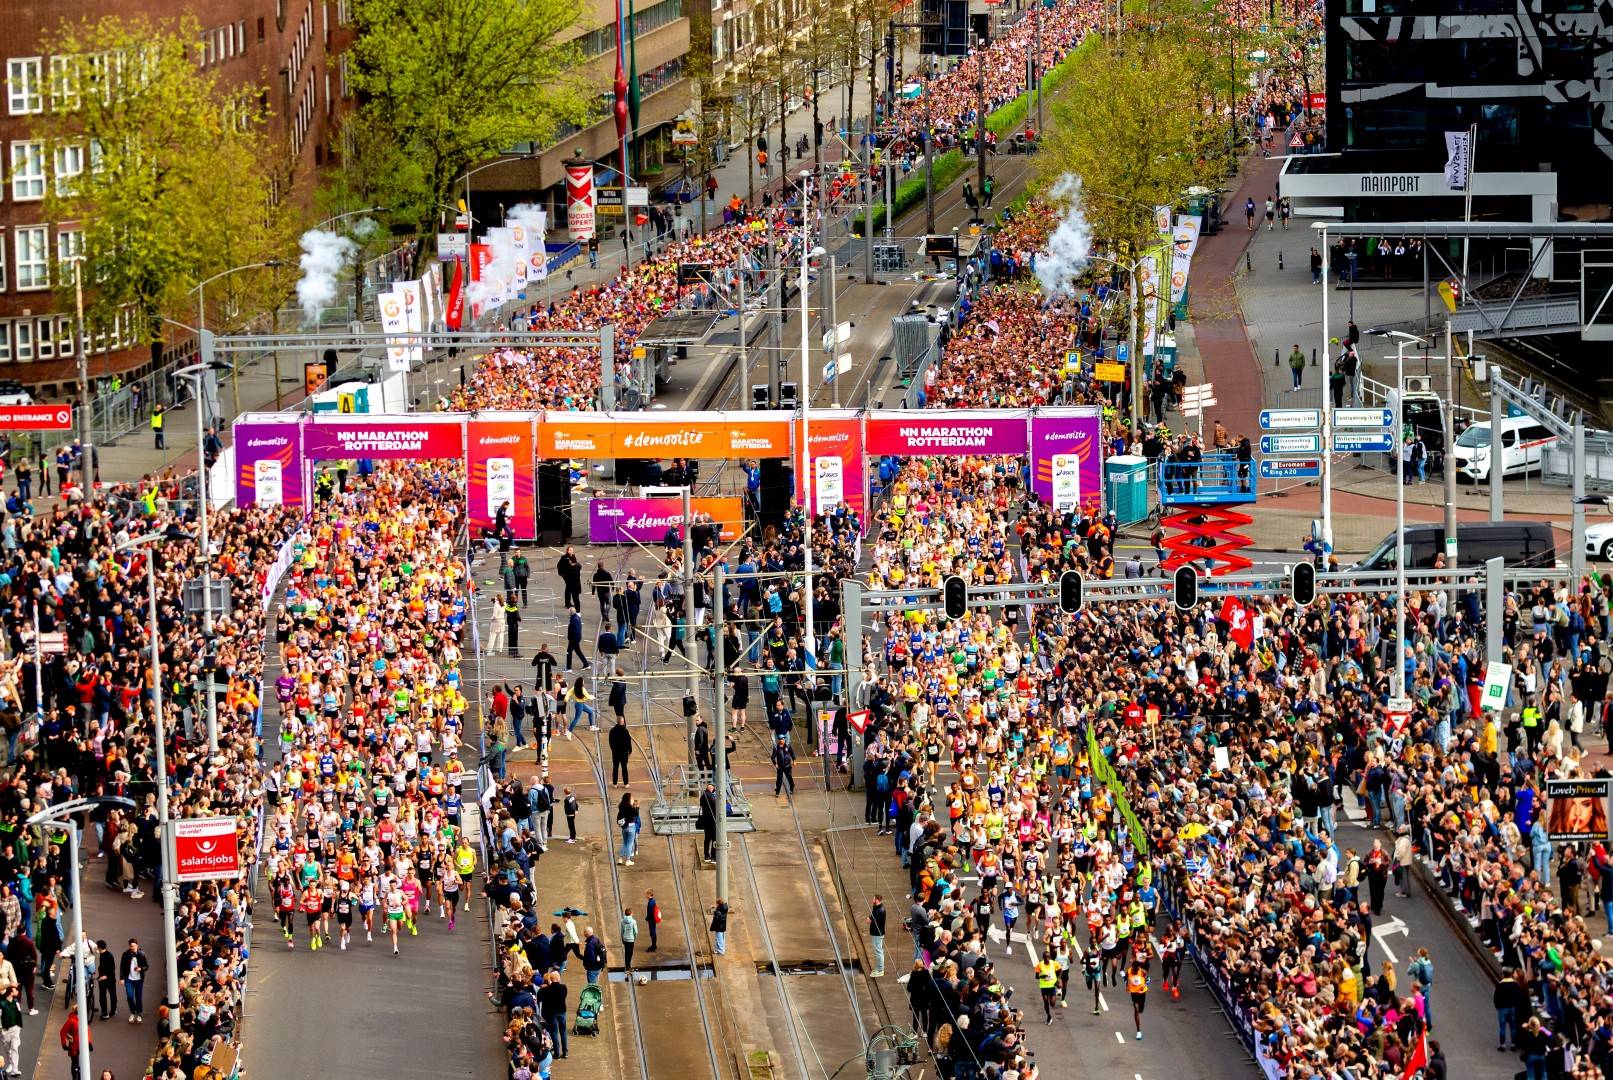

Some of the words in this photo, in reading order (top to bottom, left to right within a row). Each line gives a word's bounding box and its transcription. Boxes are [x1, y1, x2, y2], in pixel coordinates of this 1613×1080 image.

[1361, 176, 1420, 192] MAINPORT
[337, 431, 356, 441] NN
[357, 431, 428, 441] MARATHON
[900, 427, 918, 437] NN
[920, 427, 993, 436] MARATHON
[624, 430, 703, 448] #demooiste
[908, 437, 986, 446] ROTTERDAM
[345, 441, 421, 450] ROTTERDAM
[181, 854, 234, 866] salarisjobs
